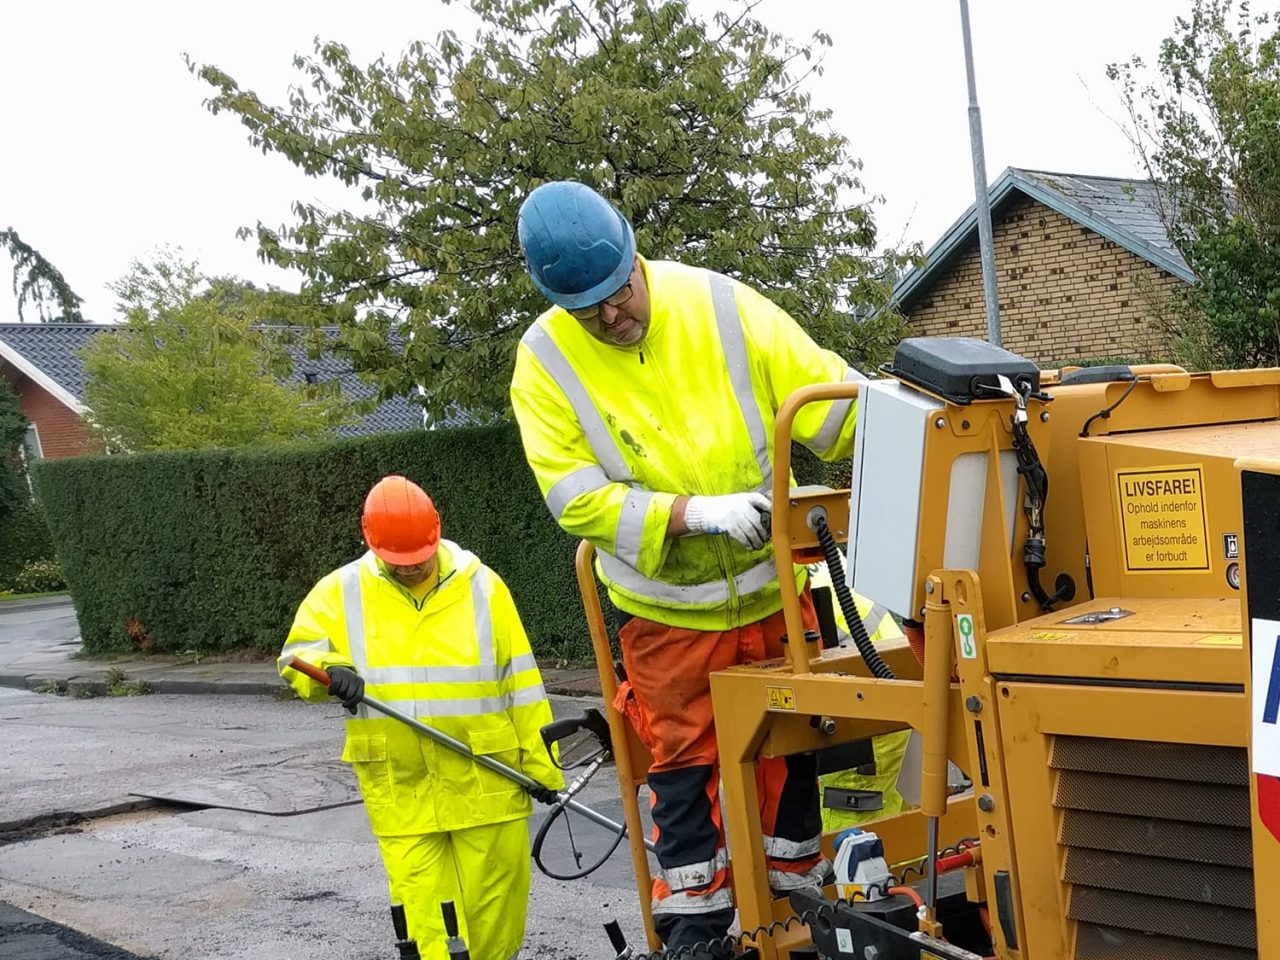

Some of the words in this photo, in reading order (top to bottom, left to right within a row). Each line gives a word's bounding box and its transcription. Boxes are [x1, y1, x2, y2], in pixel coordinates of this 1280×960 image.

[1125, 478, 1196, 497] LIVSFARE!
[1127, 502, 1159, 516] Ophold
[1161, 501, 1197, 513] indenfor
[1140, 517, 1187, 530] maskinens
[1132, 533, 1198, 549] arbejdsområde
[1145, 553, 1155, 562] er
[1156, 550, 1188, 562] forbudt
